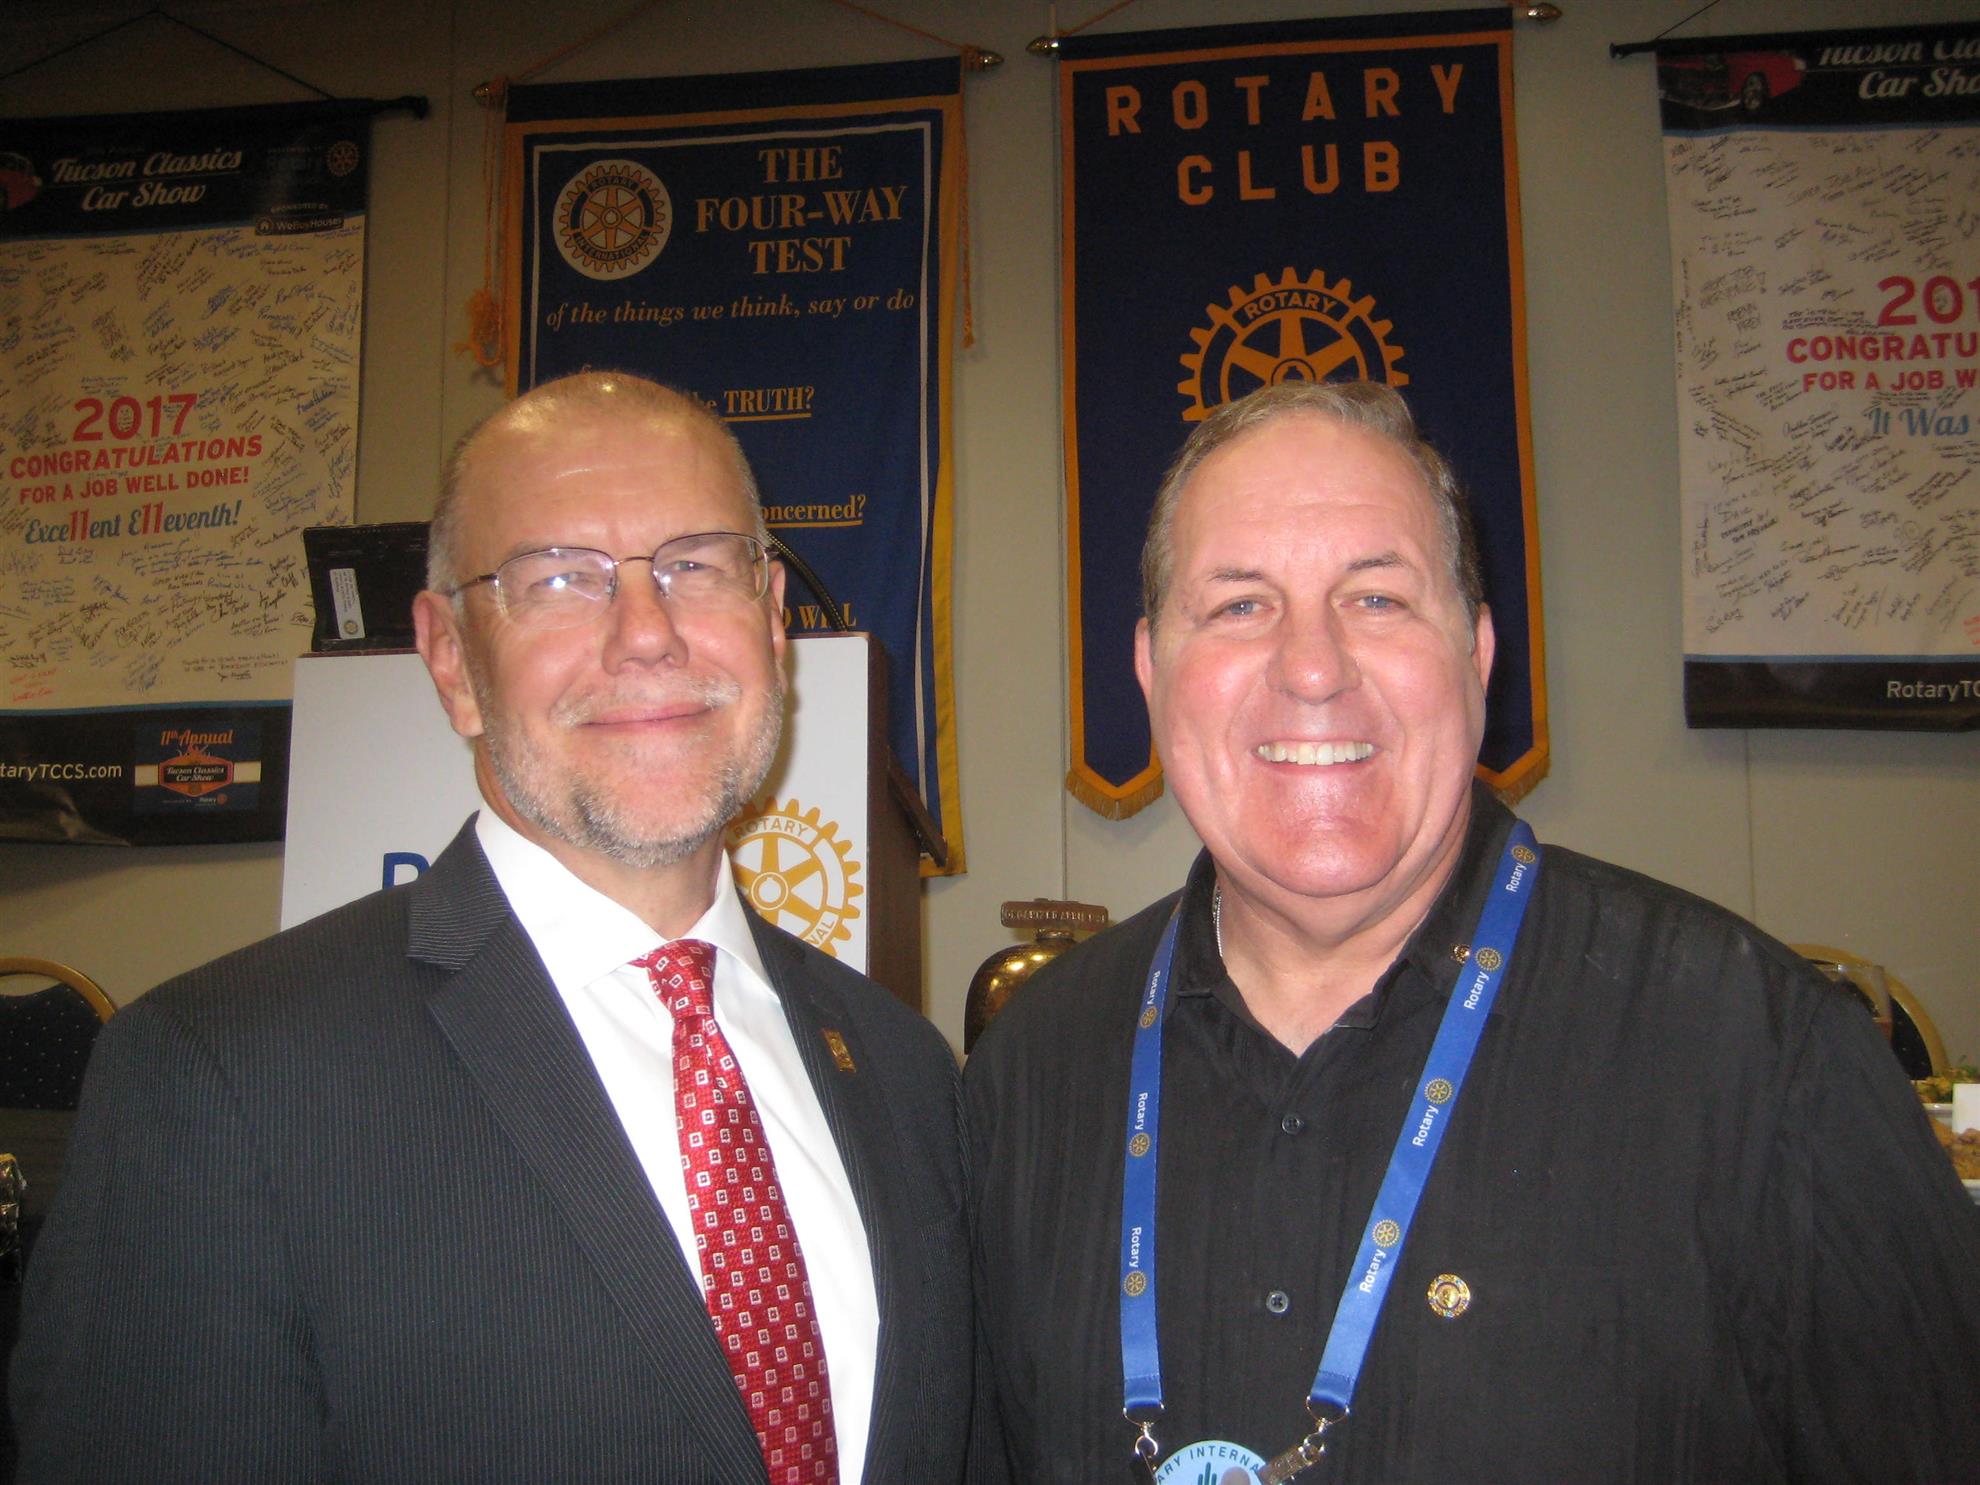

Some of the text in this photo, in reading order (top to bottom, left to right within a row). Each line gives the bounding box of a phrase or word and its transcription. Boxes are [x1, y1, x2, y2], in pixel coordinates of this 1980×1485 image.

[1105, 64, 1464, 137] ROTARY
[1858, 70, 1920, 99] Car
[52, 147, 243, 184] Tucson Classics
[591, 176, 634, 189] ROTARY
[758, 146, 844, 184] THE
[1177, 140, 1400, 206] CLUB
[81, 180, 206, 212] Car Show
[695, 186, 909, 233] FOUR-WAY
[576, 232, 649, 261] INTERNATIONAL
[749, 236, 852, 275] TEST
[545, 288, 915, 331] of the things we think, say or do
[1243, 290, 1338, 323] ROTARY
[1786, 332, 1978, 364] CONGRATU
[723, 386, 815, 414] TRUTH?
[1802, 371, 1855, 393] FOR
[1864, 371, 1881, 391] A
[1890, 370, 1944, 392] JOB
[72, 393, 198, 442] 2017
[1900, 407, 1970, 437] Was
[9, 434, 263, 480] CONGRATULATIONS
[19, 466, 249, 505] FOR A JOB WELL DONE!
[761, 494, 866, 522] oncerned?
[799, 603, 857, 630] WIL
[178, 728, 235, 746] Annual
[734, 817, 809, 840] ROTARY
[1505, 862, 1528, 893] Rotary
[1463, 971, 1490, 1010] Rotary
[1135, 1092, 1148, 1130] Rotary
[1411, 1104, 1439, 1147] Rotary
[1128, 1227, 1142, 1268] Rotary
[1359, 1248, 1386, 1293] Rotary
